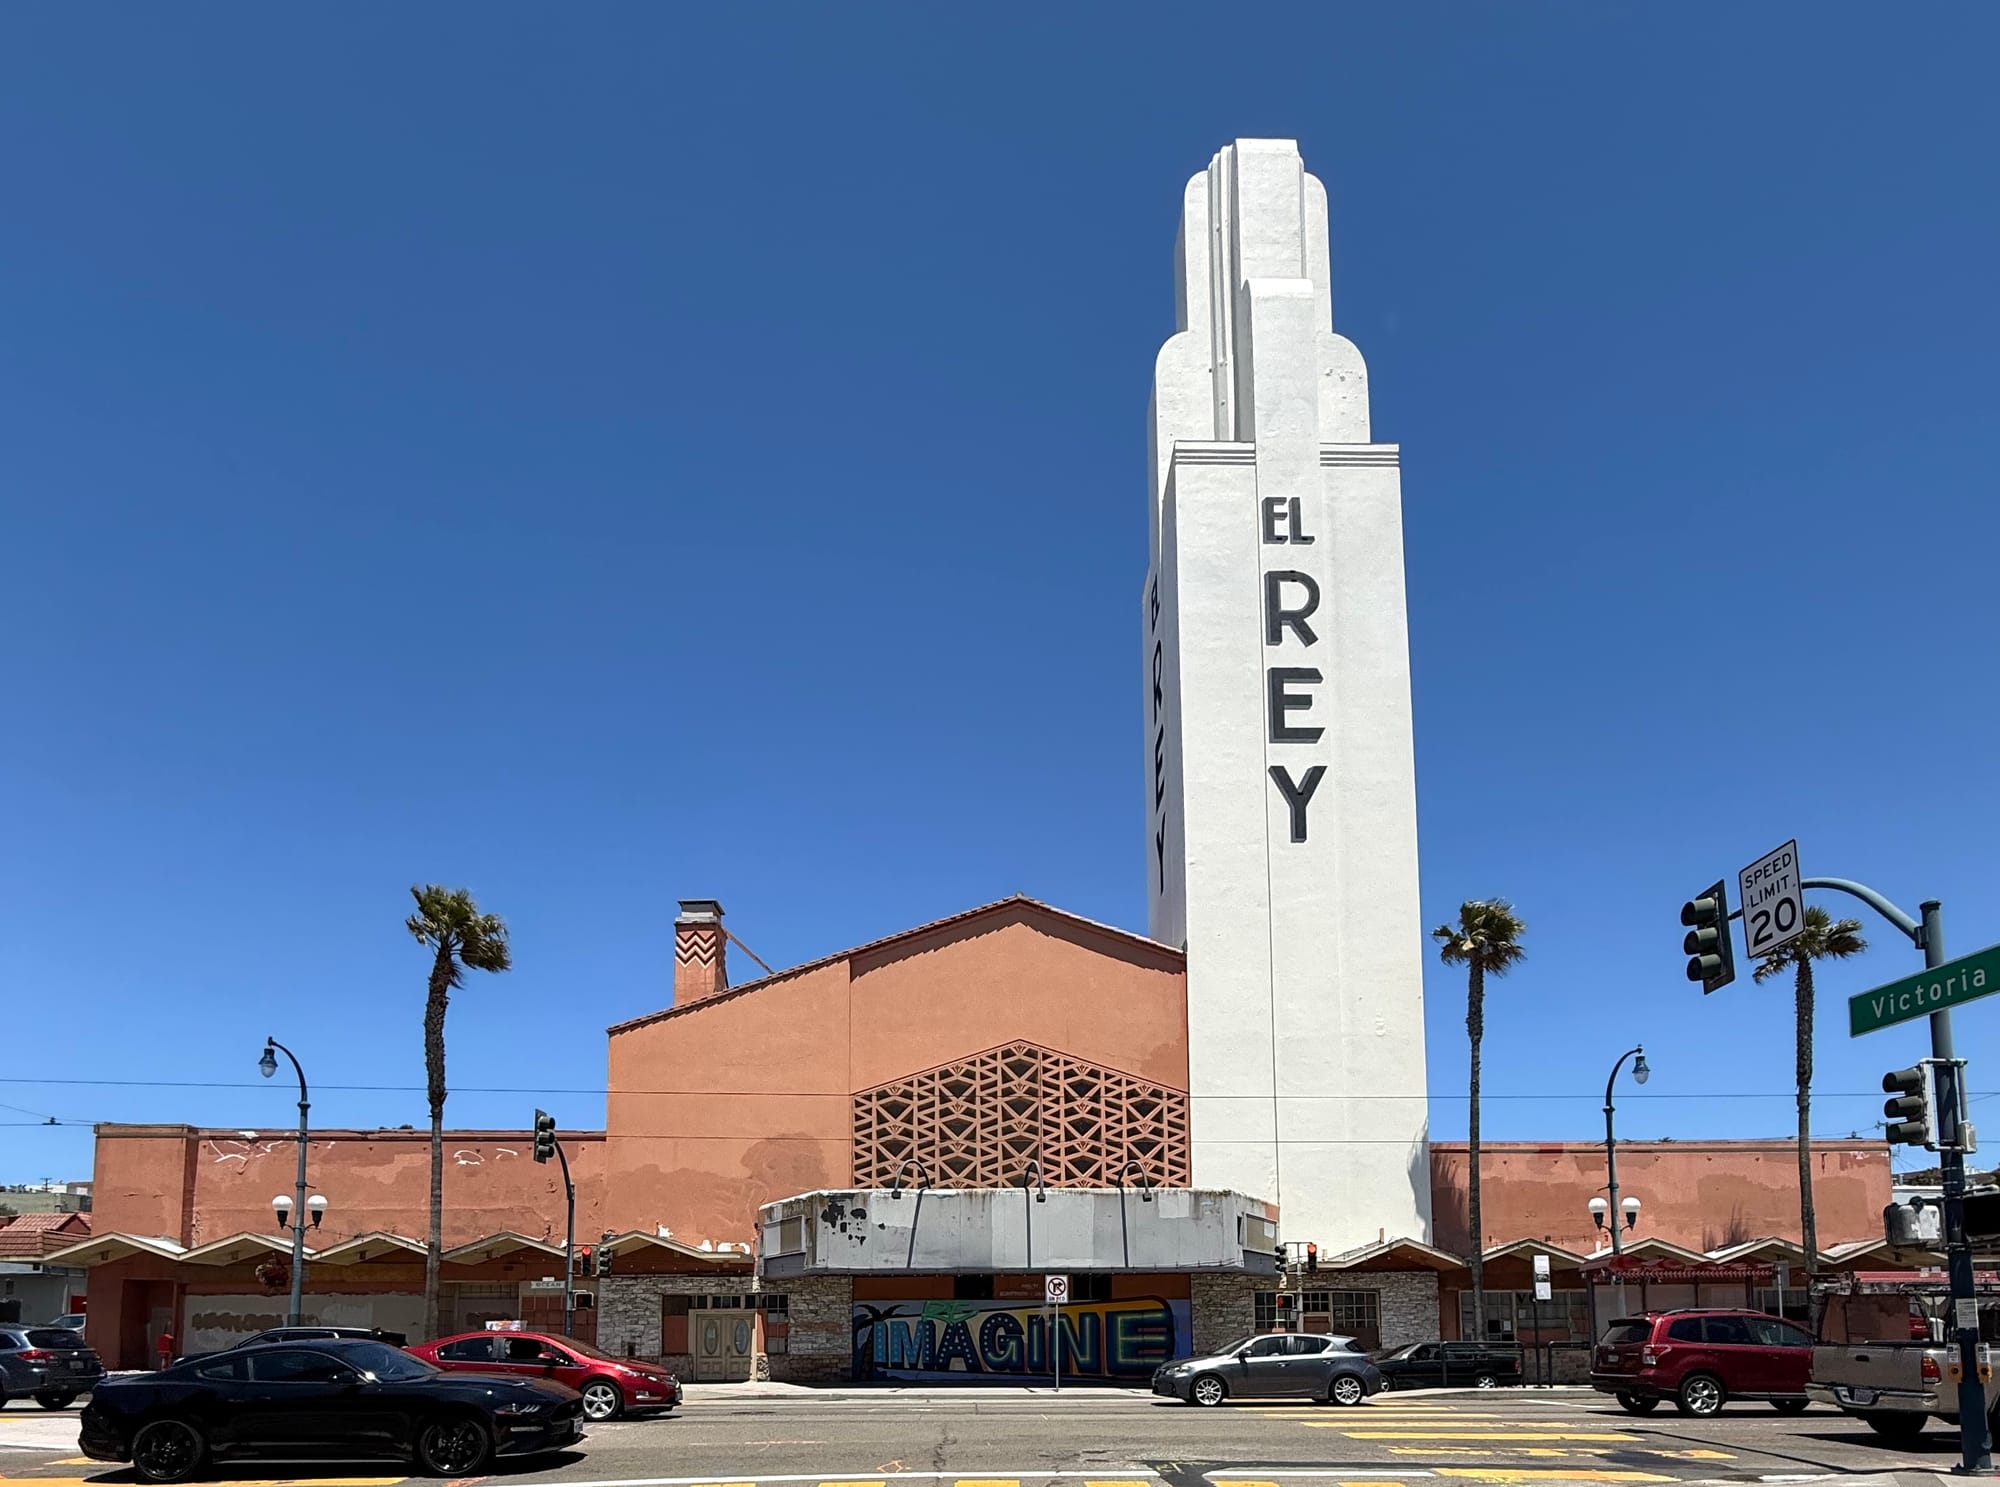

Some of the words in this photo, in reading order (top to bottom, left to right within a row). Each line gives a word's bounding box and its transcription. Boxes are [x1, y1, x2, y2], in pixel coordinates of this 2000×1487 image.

[1262, 496, 1315, 545] EL
[1263, 570, 1328, 843] REY
[1745, 852, 1792, 889] SPEED
[1750, 874, 1789, 908] LIMIT
[1750, 897, 1797, 948] 20
[1872, 968, 1986, 1019] Victoria
[873, 1308, 1172, 1374] IMAGINE
